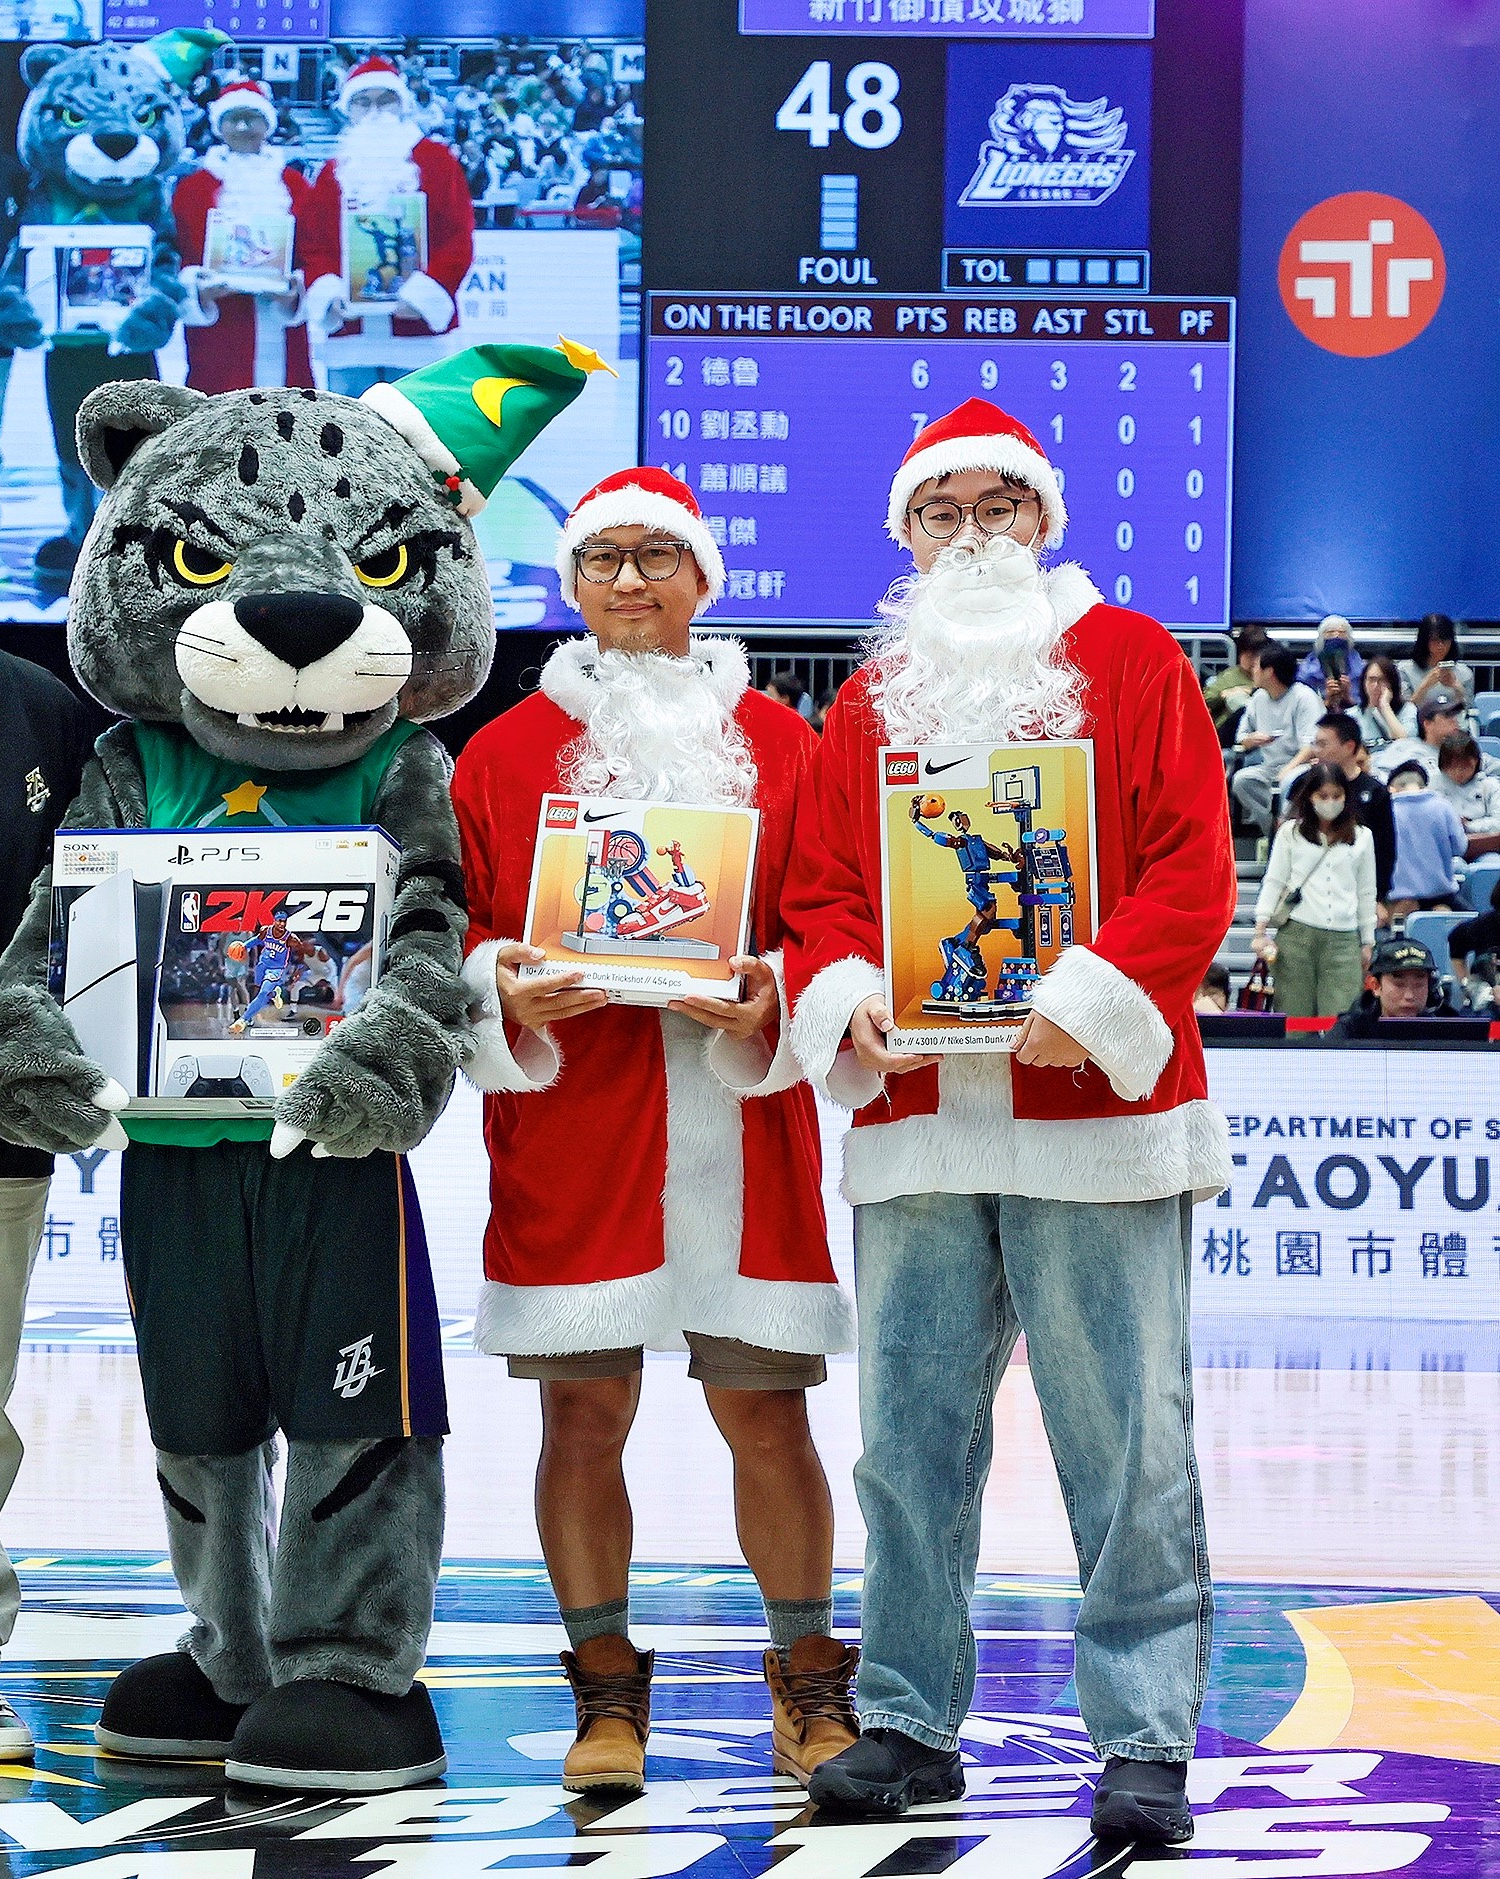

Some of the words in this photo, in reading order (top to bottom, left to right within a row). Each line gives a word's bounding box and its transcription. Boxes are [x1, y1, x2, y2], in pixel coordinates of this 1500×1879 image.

[776, 60, 903, 149] 48
[799, 256, 878, 285] FOUL
[961, 259, 1012, 284] TOL
[664, 303, 712, 331] ON
[717, 304, 773, 332] THE
[778, 305, 873, 333] FLOOR
[896, 307, 948, 333] PTS
[964, 307, 1018, 334] REB
[1032, 307, 1087, 335] AST
[1104, 308, 1155, 336] STL
[1180, 310, 1215, 336] PF
[664, 355, 685, 387] 2
[911, 358, 930, 390] 6
[980, 359, 999, 391] 9
[1050, 360, 1068, 391] 3
[1118, 361, 1137, 392] 2
[1189, 361, 1203, 392] 1
[657, 409, 692, 440] 10
[1051, 413, 1064, 444] 1
[1117, 414, 1136, 446] 0
[1188, 415, 1202, 446] 1
[1116, 467, 1135, 499] 0
[1185, 468, 1204, 500] 0
[1116, 520, 1135, 552] 0
[1185, 521, 1203, 553] 0
[720, 569, 787, 600] 冠軒
[1114, 574, 1132, 605] 0
[1186, 575, 1199, 605] 1
[888, 762, 917, 775] LEGO
[548, 807, 577, 820] LEGO
[63, 844, 99, 852] SONY
[201, 847, 261, 861] PS5
[200, 889, 370, 933] 2K26
[592, 972, 611, 981] Dunk
[610, 974, 644, 984] Trickshot
[652, 977, 668, 986] 454
[668, 979, 682, 987] pcs
[915, 1037, 938, 1046] 43010
[947, 1036, 964, 1045] Nike
[964, 1036, 984, 1045] Slam
[985, 1035, 1004, 1044] Dunk
[1226, 1115, 1417, 1139] EPARTMENT
[1430, 1118, 1473, 1139] OF
